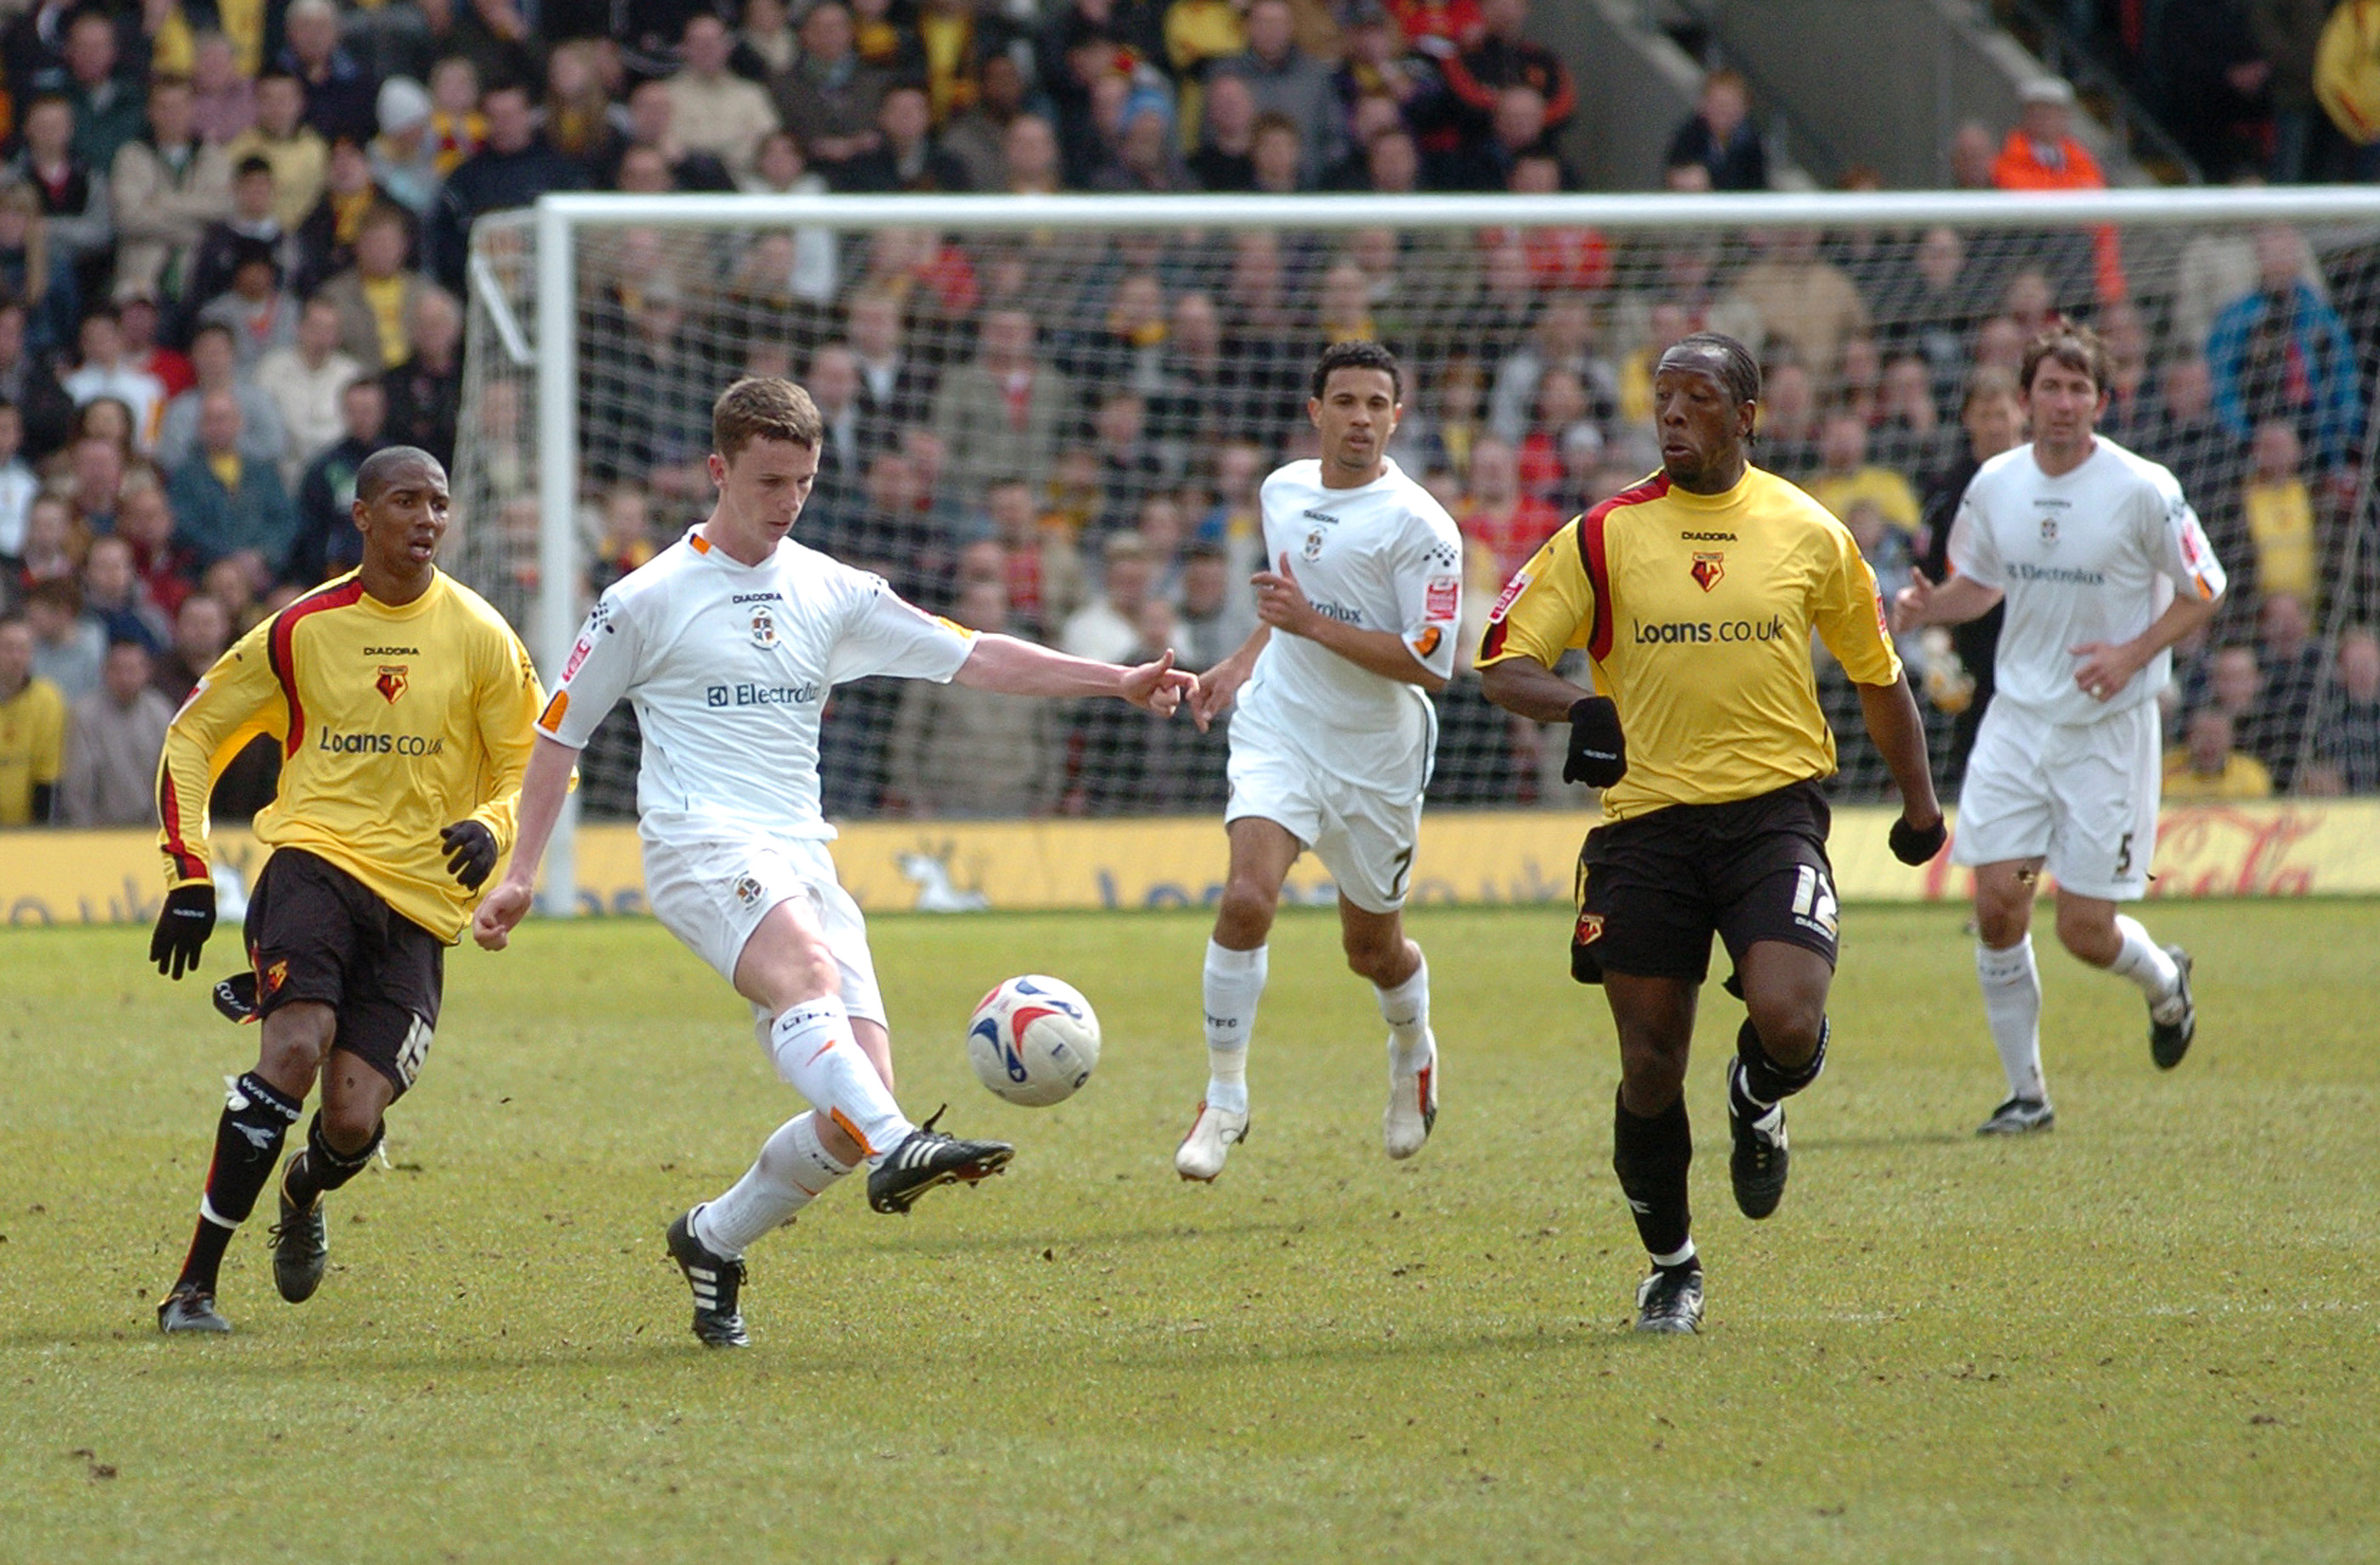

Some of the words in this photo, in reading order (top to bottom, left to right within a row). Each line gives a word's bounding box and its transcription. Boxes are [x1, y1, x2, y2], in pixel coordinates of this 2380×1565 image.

[1681, 530, 1737, 542] DIADORA
[1633, 613, 1784, 644] Loans.co.uk
[1394, 843, 1414, 899] 7
[2115, 832, 2134, 876] 5
[1791, 864, 1838, 937] 12
